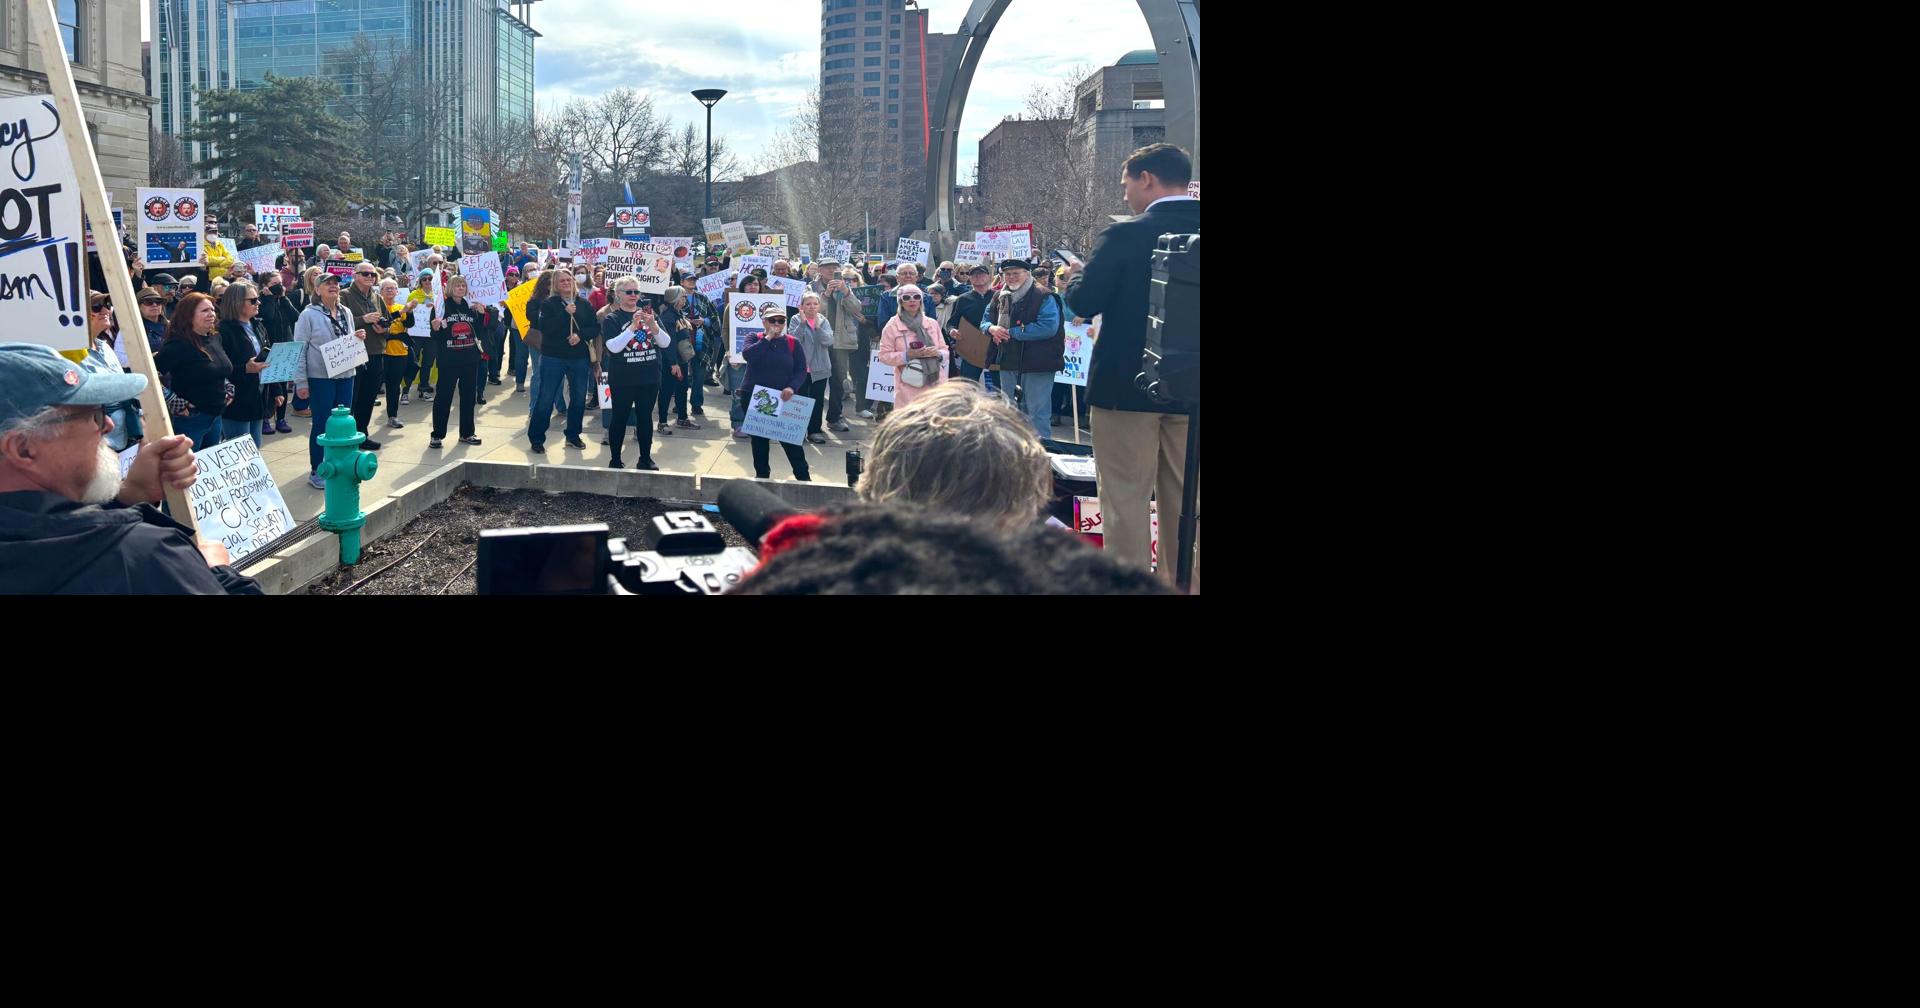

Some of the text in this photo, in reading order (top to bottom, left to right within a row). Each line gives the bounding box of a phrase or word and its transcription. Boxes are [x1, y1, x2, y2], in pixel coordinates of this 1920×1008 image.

[262, 206, 298, 215] UNITE
[610, 240, 621, 249] NO
[624, 241, 656, 252] PROJECT
[900, 238, 920, 247] MAKE
[898, 249, 919, 258] GREAT
[899, 244, 926, 253] AMERICA
[630, 250, 644, 259] YES
[896, 254, 917, 262] AGAIN
[462, 255, 483, 265] GET
[607, 255, 647, 266] EDUCATION
[606, 263, 634, 273] SCIENCE
[605, 271, 632, 281] HUMA
[207, 445, 240, 470] VETS
[220, 462, 260, 488] MEDICAID
